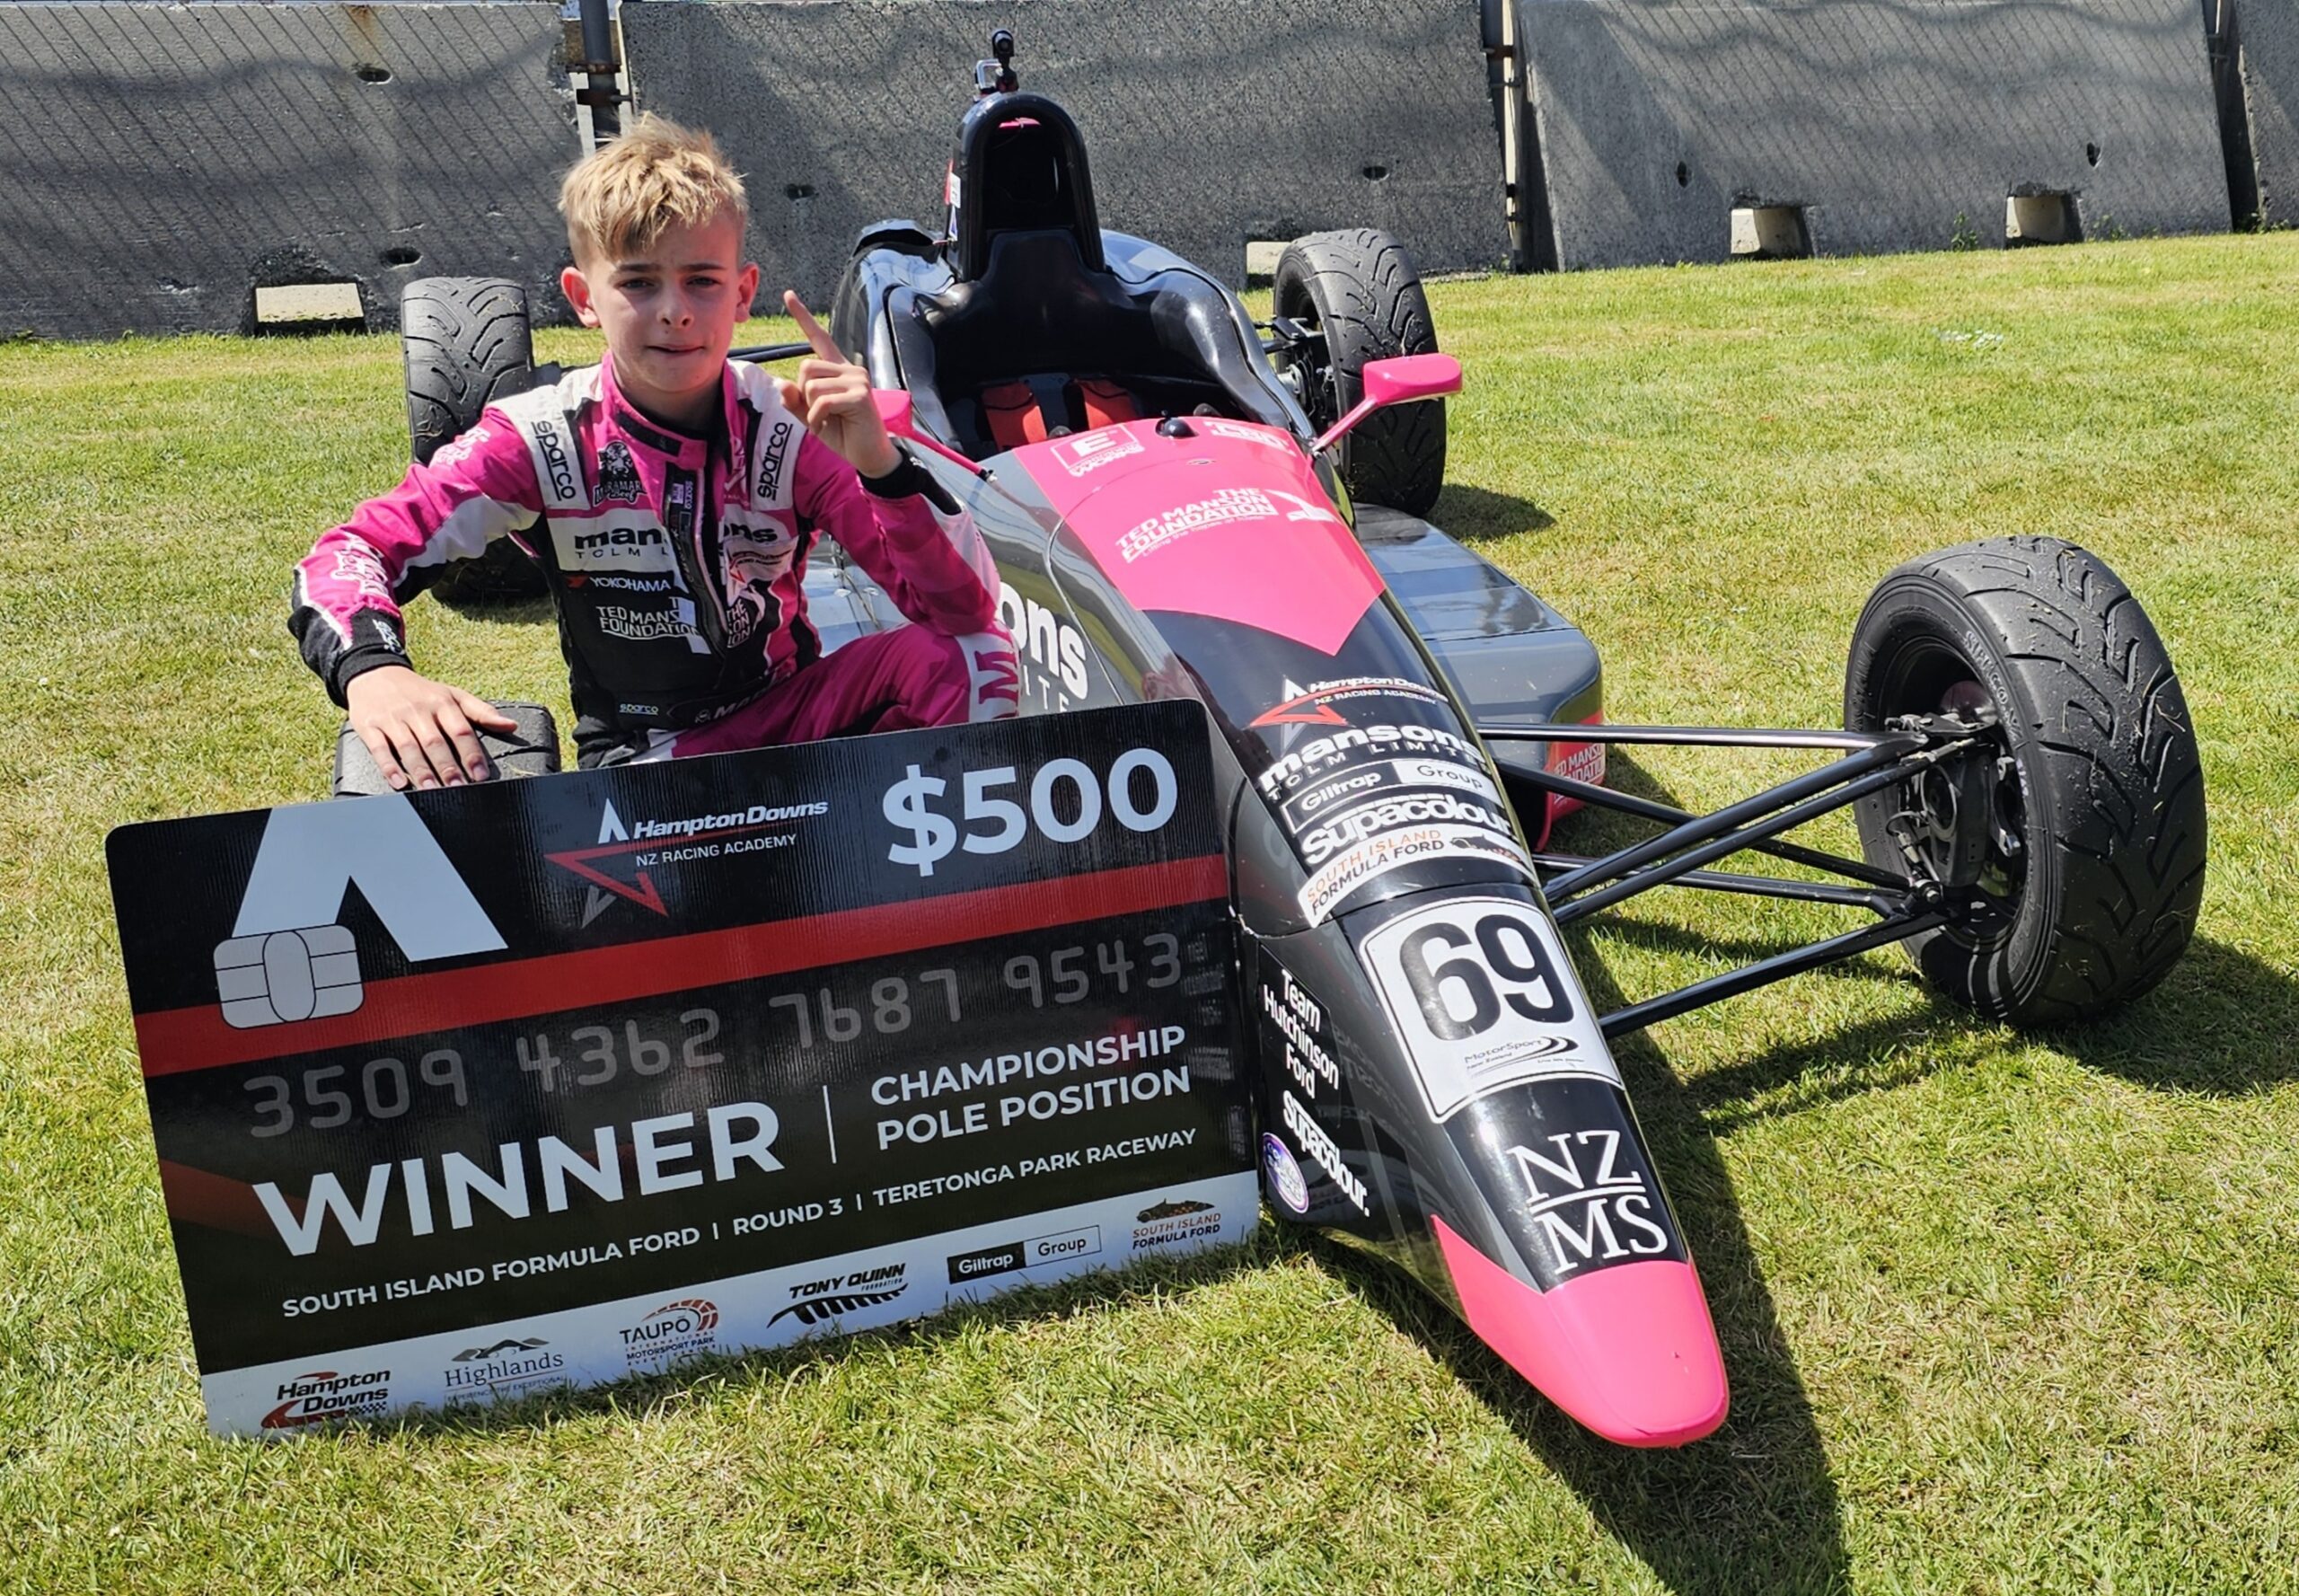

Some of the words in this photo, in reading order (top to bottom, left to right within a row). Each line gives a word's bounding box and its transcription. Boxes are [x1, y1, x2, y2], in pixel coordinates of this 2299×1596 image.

[536, 420, 576, 499] sparco
[758, 422, 788, 499] sparco
[1213, 488, 1260, 499] THE
[575, 527, 667, 550] man
[1115, 518, 1158, 547] TED
[1161, 494, 1271, 522] MANSON
[1122, 503, 1278, 560] FOUNDATION
[589, 577, 672, 592] YOKOHAMA
[595, 606, 627, 621] TED
[630, 610, 681, 624] MANS
[620, 703, 658, 715] sparco
[1309, 677, 1393, 693] Hampton
[1315, 696, 1334, 706] NZ
[1335, 690, 1381, 701] RACING
[1259, 725, 1486, 791] mansons
[882, 747, 1178, 877] $500
[1301, 773, 1382, 810] Giltrap
[1416, 763, 1484, 789] Group
[633, 810, 746, 840] Hampton
[746, 800, 828, 824] Downs
[636, 854, 658, 867] NZ
[662, 844, 719, 863] RACING
[724, 833, 797, 855] ACADEMY
[1308, 851, 1361, 901] SOUTH
[1368, 830, 1441, 856] ISLAND
[1312, 852, 1388, 916] FORMULA
[1394, 839, 1445, 859] FORD
[1282, 969, 1321, 1033] Team
[1399, 914, 1574, 1041] 69
[243, 1049, 468, 1138] 3509
[515, 1008, 724, 1092] 4362
[769, 968, 961, 1048] 7687
[1003, 933, 1181, 1009] 9543
[1264, 983, 1339, 1090] Hutchinson
[871, 1025, 1186, 1107] CHAMPIONSHIP
[1286, 1042, 1316, 1099] Ford
[876, 1101, 990, 1151] POLE
[1000, 1065, 1193, 1126] POSITION
[252, 1101, 785, 1257] WINNER
[1507, 1130, 1643, 1204] NZ
[282, 1285, 377, 1318] SOUTH
[384, 1266, 485, 1301] ISLAND
[492, 1242, 622, 1282] FORMULA
[629, 1227, 700, 1256] FORD
[732, 1203, 824, 1237] ROUND
[828, 1198, 844, 1217] 3
[873, 1167, 1015, 1207] TERETONGA
[1019, 1151, 1082, 1178] PARK
[1087, 1128, 1198, 1164] RACEWAY
[1132, 1221, 1175, 1239] SOUTH
[1177, 1212, 1221, 1230] ISLAND
[1132, 1230, 1187, 1250] FORMULA
[1190, 1223, 1221, 1238] FORD
[1532, 1195, 1669, 1274] MS
[789, 1275, 846, 1299] TONY
[848, 1263, 906, 1287] QUINN
[958, 1253, 1014, 1274] Giltrap
[1037, 1237, 1087, 1257] Group
[445, 1352, 564, 1388] Highlands
[627, 1341, 689, 1361] MOTORSPORT
[691, 1336, 716, 1346] PARK
[277, 1370, 391, 1400] Hampton
[303, 1388, 388, 1413] Downs
